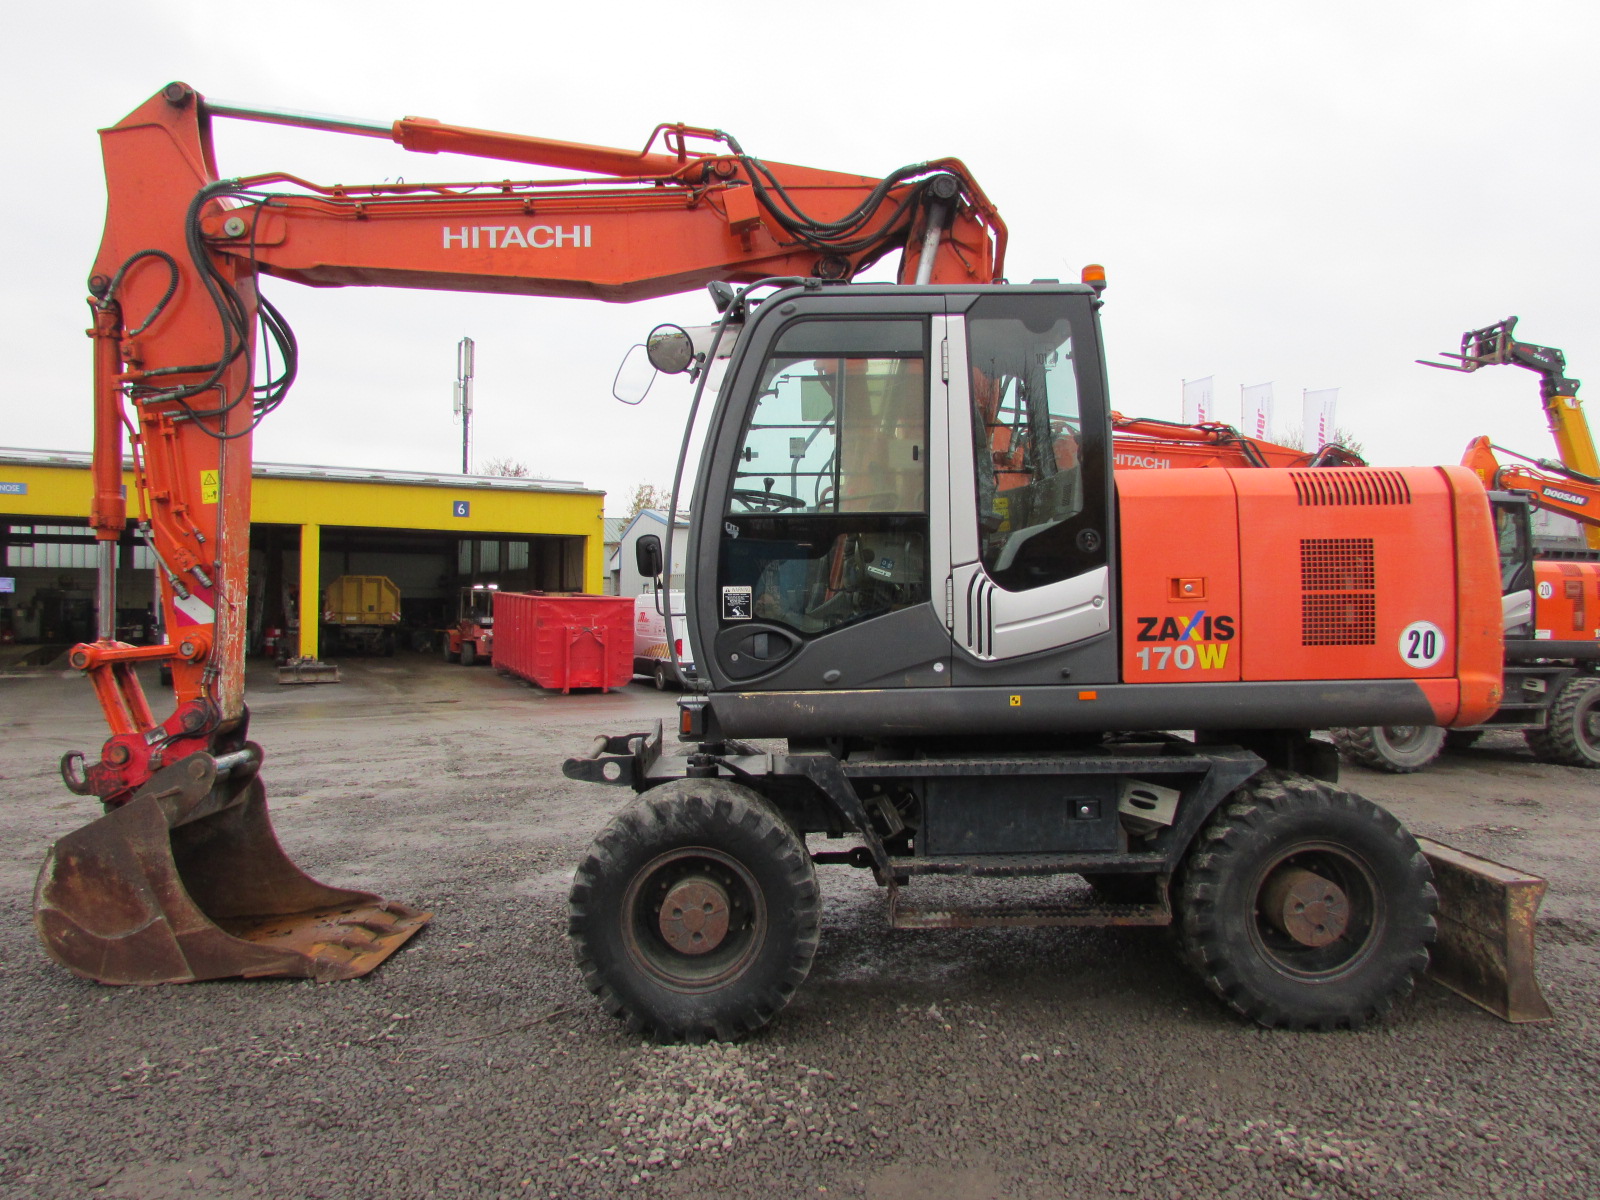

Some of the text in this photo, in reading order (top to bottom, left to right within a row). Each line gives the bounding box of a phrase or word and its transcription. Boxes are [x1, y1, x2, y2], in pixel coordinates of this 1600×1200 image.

[443, 225, 592, 249] HITACHI
[1543, 488, 1585, 505] DOOSAN
[457, 503, 466, 515] 6
[1540, 584, 1550, 596] 20
[1137, 610, 1235, 642] ZAXIS
[1407, 629, 1436, 660] 20
[1136, 643, 1229, 671] 170W
